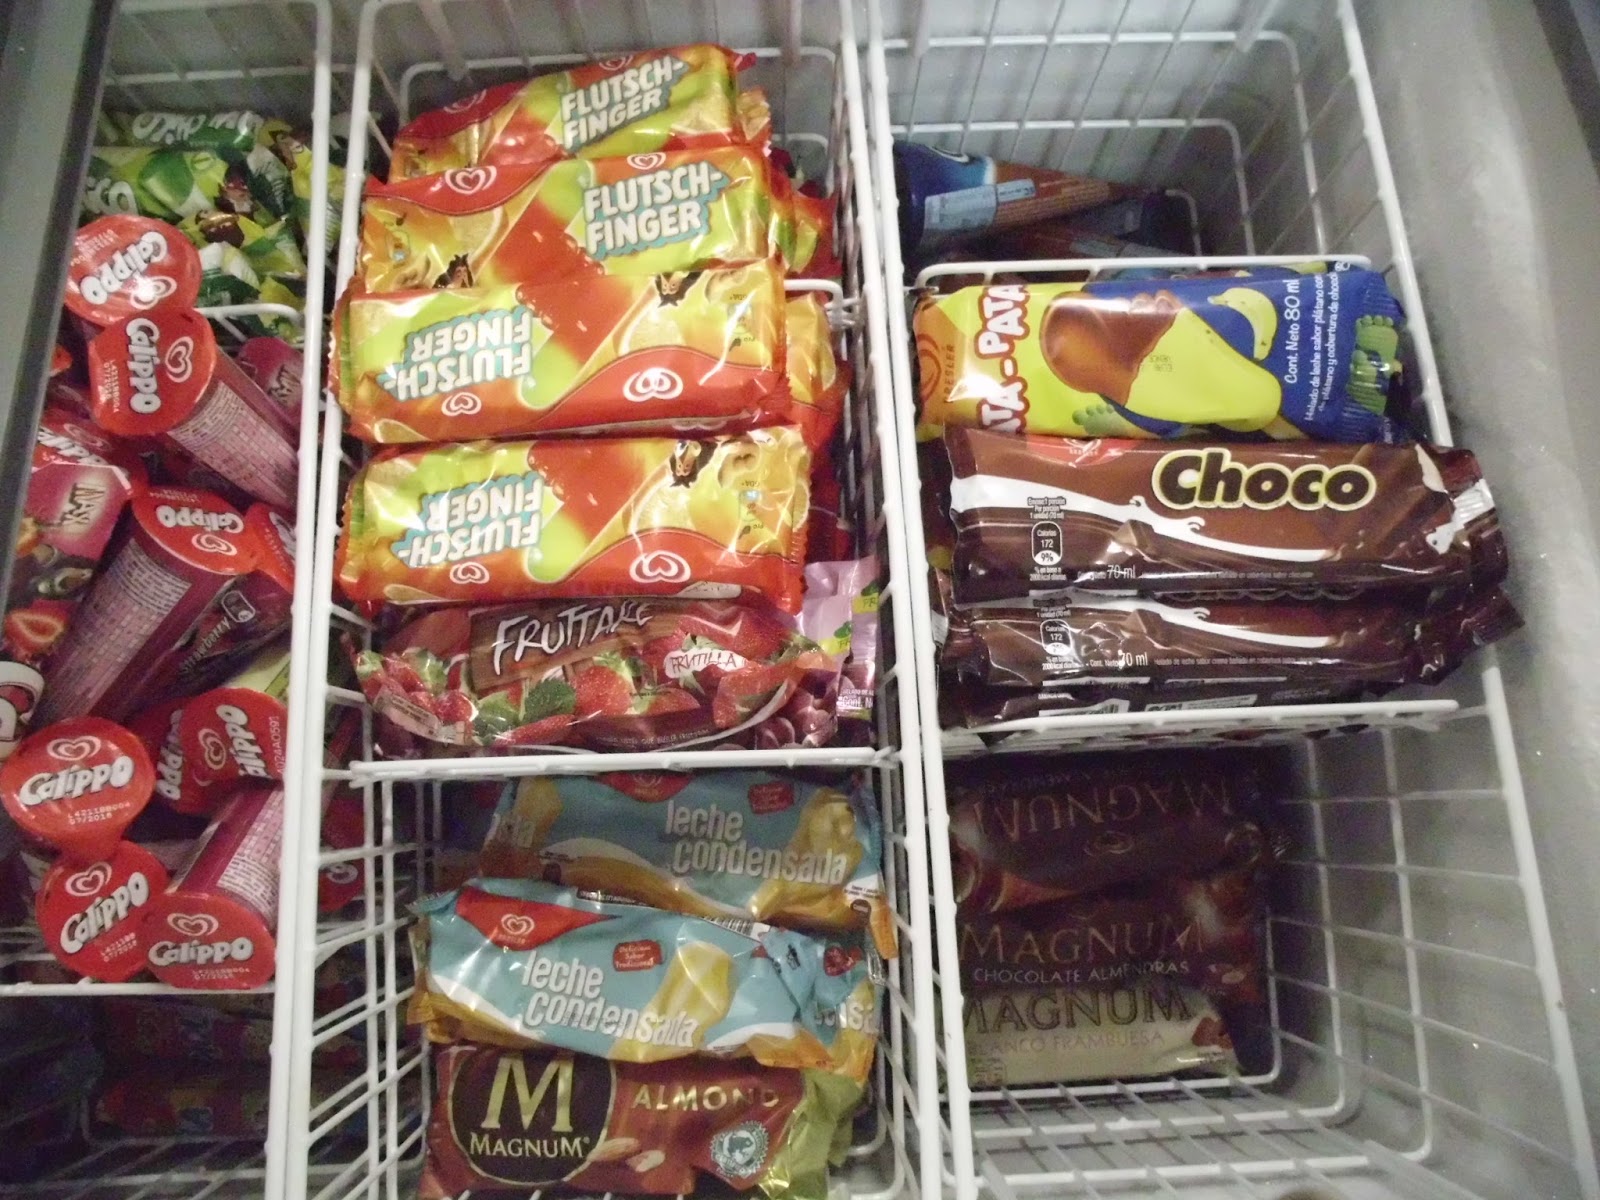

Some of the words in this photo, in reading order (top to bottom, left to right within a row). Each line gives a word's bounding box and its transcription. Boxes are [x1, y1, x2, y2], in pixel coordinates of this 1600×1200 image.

[561, 55, 685, 123] FLUTSCH-
[563, 87, 663, 151] FINGER
[583, 162, 724, 224] FLUTSCH-
[586, 203, 702, 255] FINGER
[80, 231, 168, 305] Calippo
[1282, 279, 1300, 294] ml
[1284, 295, 1300, 322] 80
[1329, 300, 1340, 314] de
[411, 310, 532, 359] FINGER
[1285, 323, 1300, 351] Neto
[1310, 326, 1322, 351] sabor
[126, 317, 162, 414] Calippo
[377, 342, 532, 401] FLUTSCH-
[1284, 353, 1299, 384] Cont.
[1312, 372, 1321, 388] de
[429, 477, 543, 524] FINGER
[1152, 448, 1377, 512] Choco
[66, 482, 106, 527] MAX
[156, 506, 244, 534] Calippo
[397, 512, 543, 569] FLUTSCH-
[1040, 539, 1054, 548] 172
[1040, 553, 1054, 561] 9%
[1106, 564, 1121, 579] 70
[1122, 564, 1136, 579] ml
[491, 600, 653, 676] FRUTTARE
[1049, 633, 1063, 641] 172
[1135, 651, 1148, 666] ml
[670, 651, 737, 674] FRUTILLA
[215, 704, 272, 779] alippo
[19, 755, 134, 806] Calippo
[665, 800, 743, 842] leche
[972, 777, 1233, 844] MAGNUM
[672, 838, 848, 885] condensada
[60, 872, 149, 954] Calippo
[149, 937, 253, 967] Calippo
[960, 916, 1204, 965] MAGNUM
[522, 951, 603, 999] leche
[973, 967, 1081, 984] CHOCOLATE
[1087, 960, 1190, 982] ALMENDRAS
[524, 992, 700, 1048] condensada
[480, 1053, 575, 1132] M
[631, 1083, 781, 1112] ALMOND
[470, 1131, 584, 1159] MAGNUM
